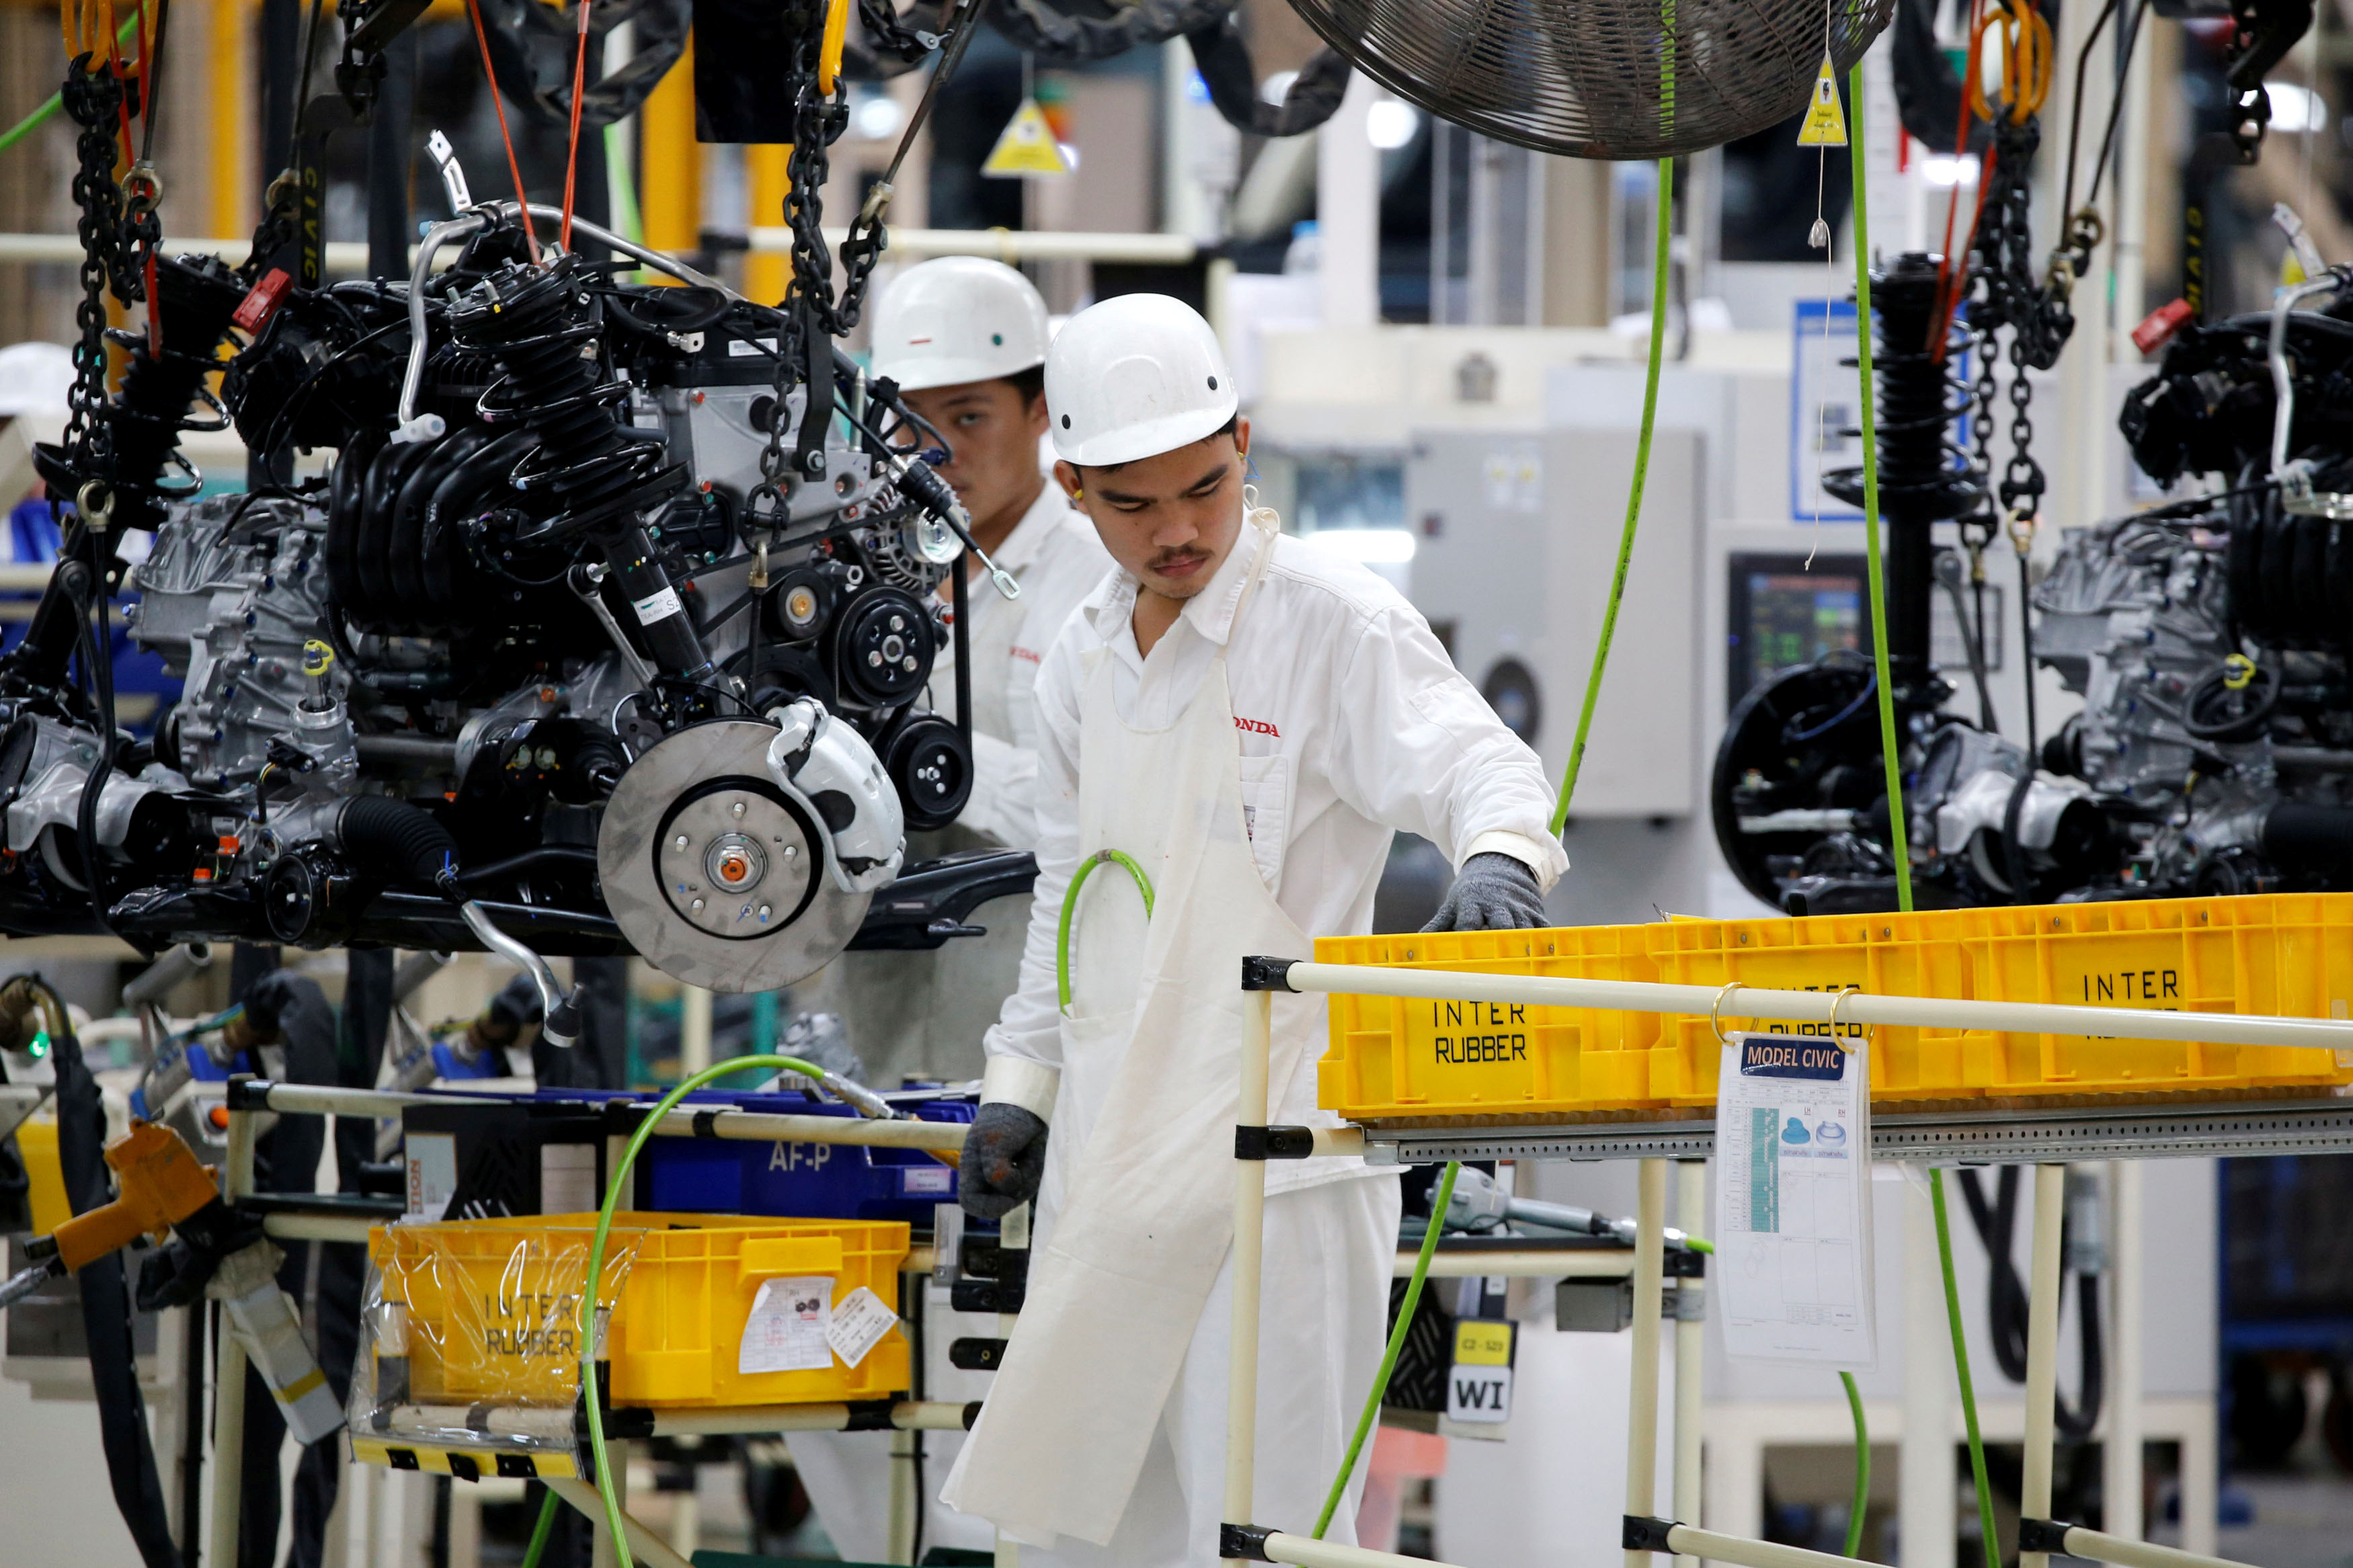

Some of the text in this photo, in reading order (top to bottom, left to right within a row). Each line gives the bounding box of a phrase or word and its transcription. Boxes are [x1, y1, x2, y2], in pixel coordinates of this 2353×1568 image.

[305, 167, 317, 280] CIVIC
[1233, 716, 1281, 737] ONDA
[2084, 970, 2178, 1001] INTER
[1434, 1000, 1525, 1027] INTER
[1435, 1034, 1527, 1064] RUBBER
[1748, 1046, 1840, 1069] MODEL CIVIC
[768, 1140, 831, 1171] AF-P
[485, 1294, 573, 1320] INTER
[487, 1329, 573, 1356] RUBBER
[1456, 1380, 1505, 1410] WI
